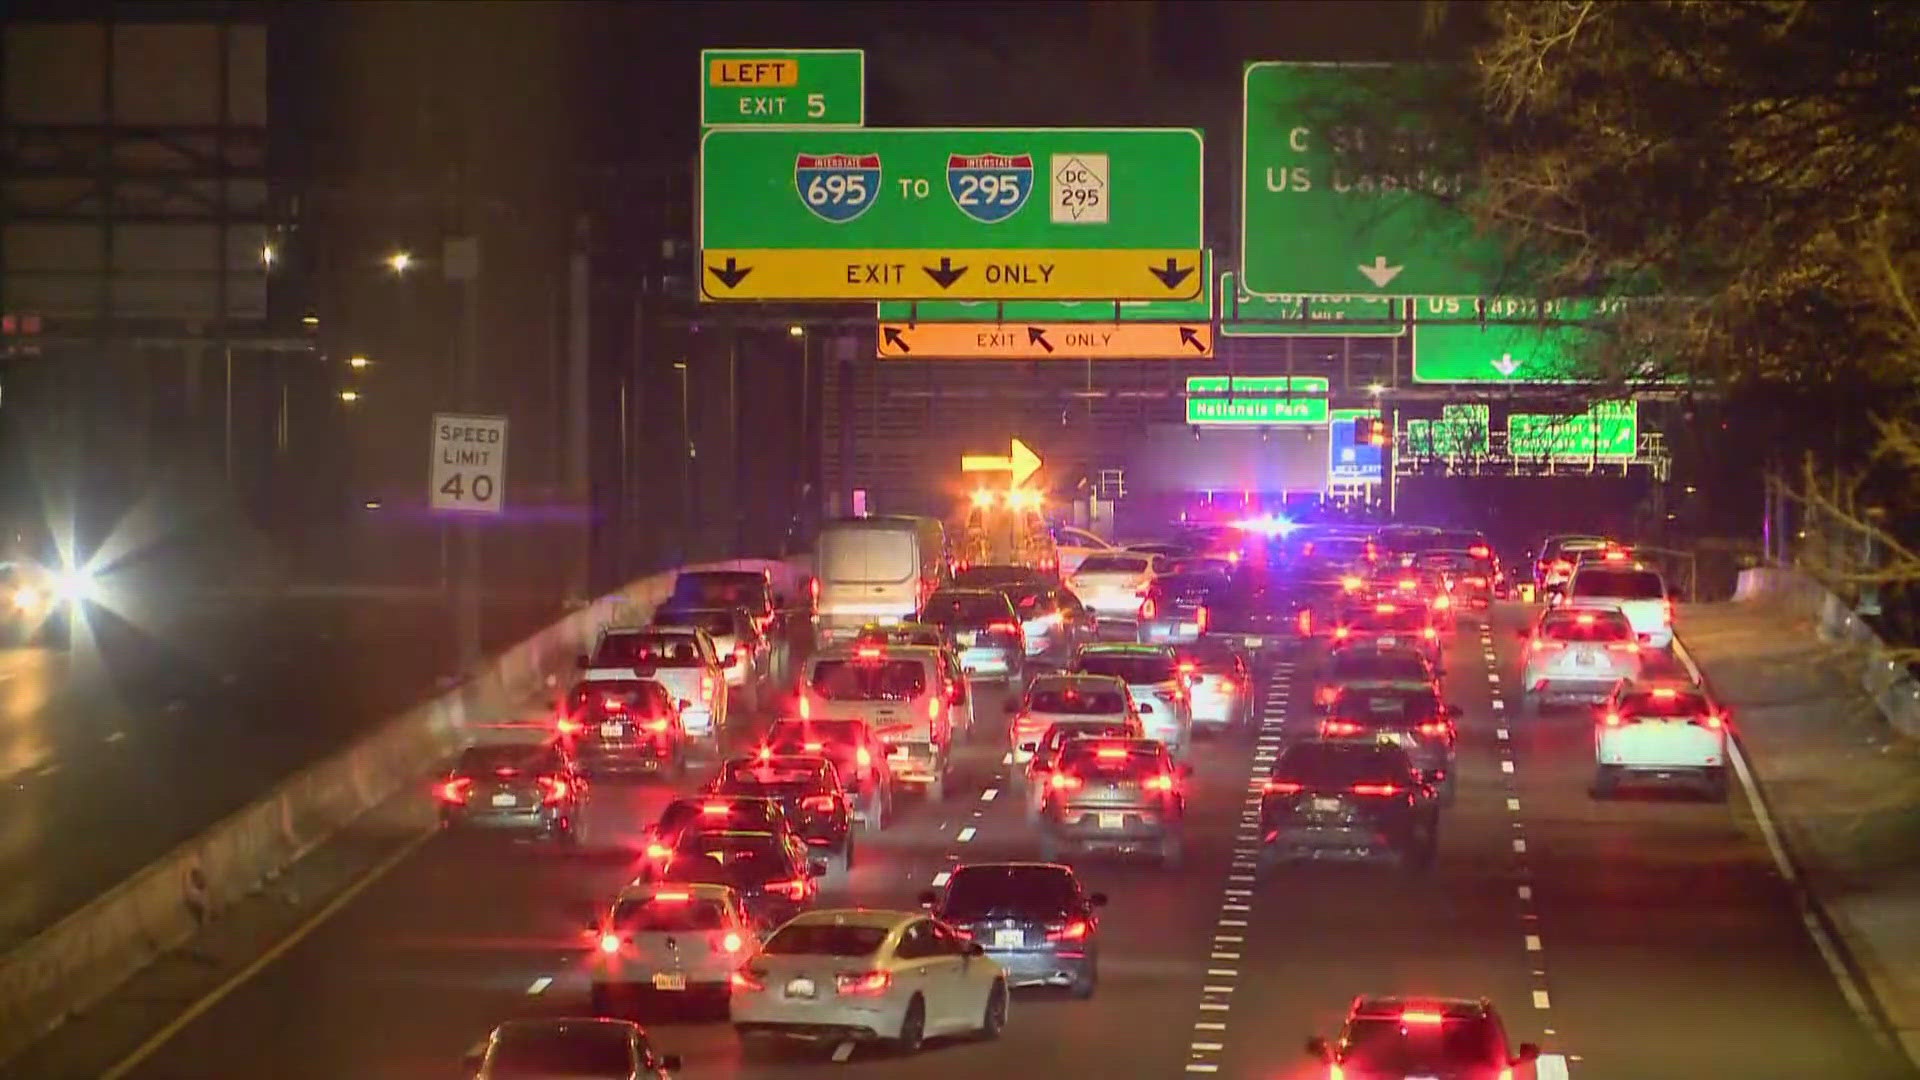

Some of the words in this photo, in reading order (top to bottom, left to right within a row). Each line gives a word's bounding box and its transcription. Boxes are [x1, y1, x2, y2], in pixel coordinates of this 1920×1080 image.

[721, 63, 785, 83] LEFT
[739, 96, 787, 115] EXIT
[807, 93, 826, 118] 5
[1289, 126, 1311, 152] C
[814, 157, 861, 168] INTERSTATE
[966, 157, 1013, 168] INTERSTATE
[1065, 169, 1088, 184] DC
[1266, 167, 1312, 193] US
[807, 174, 867, 206] 695
[897, 178, 930, 199] TO
[958, 174, 1021, 206] 295
[1061, 188, 1100, 207] 295
[847, 264, 906, 284] EXIT
[985, 264, 1056, 284] ONLY
[1429, 297, 1460, 314] US
[976, 333, 1017, 347] EXIT
[1065, 333, 1112, 347] ONLY
[1196, 402, 1268, 417] Nationals
[1274, 402, 1310, 417] Park
[440, 424, 500, 444] SPEED
[443, 448, 490, 466] LIMIT
[440, 473, 494, 502] 40
